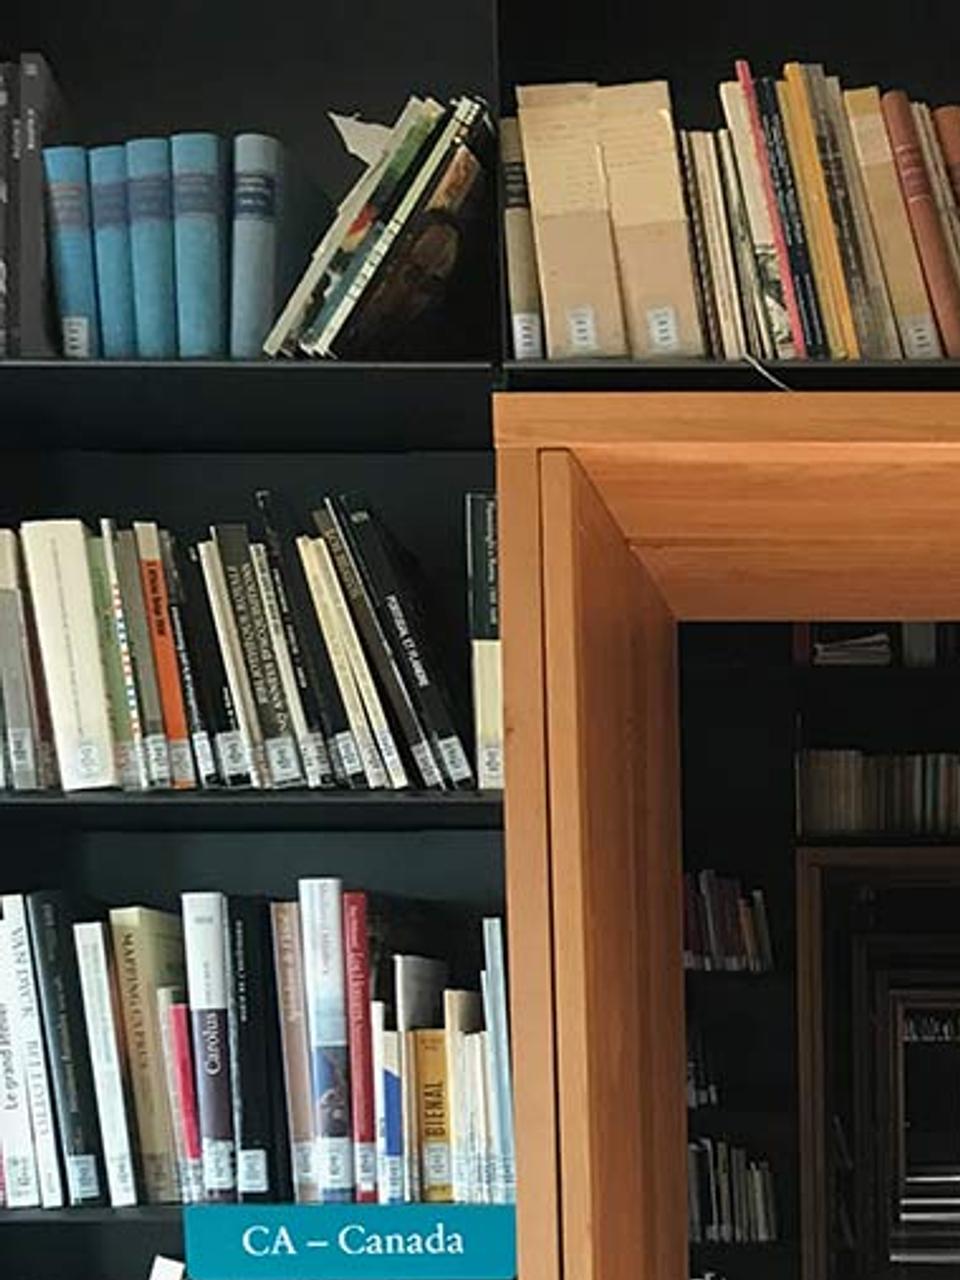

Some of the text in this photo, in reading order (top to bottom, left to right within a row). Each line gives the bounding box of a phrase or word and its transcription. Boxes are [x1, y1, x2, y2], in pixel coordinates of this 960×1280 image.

[122, 932, 140, 1007] MAPPING
[201, 1012, 222, 1075] Carolus
[423, 1080, 444, 1139] BIENAL
[242, 1225, 297, 1256] CA
[339, 1223, 465, 1256] Canada
